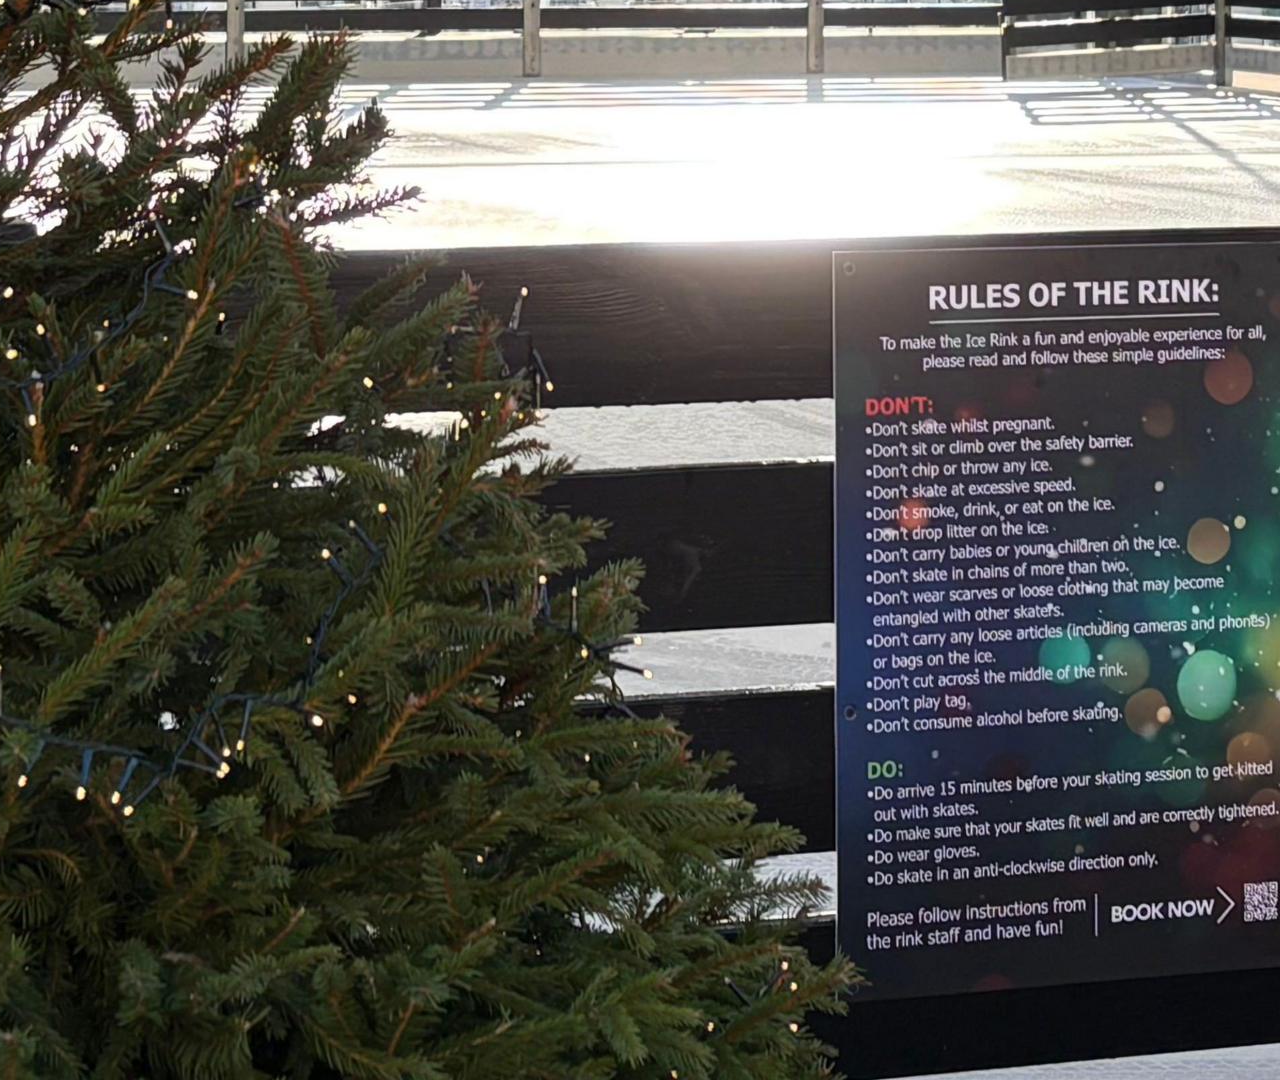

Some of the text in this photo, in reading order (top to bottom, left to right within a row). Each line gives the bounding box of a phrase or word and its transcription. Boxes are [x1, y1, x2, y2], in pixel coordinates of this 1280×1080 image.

[928, 278, 1218, 311] RULES OF THE RINK:
[879, 324, 1266, 351] To make the Ice Rink a fun and enjoyable experience for all,
[922, 345, 1225, 372] please read and follow these simple guidelines:
[865, 396, 932, 415] DON'T:
[871, 416, 1055, 436] Don't skate whilst pregnant.
[871, 433, 1134, 457] Don't sit or climb over the safety barrier.
[871, 458, 1052, 480] Don't chip or throw any ice.
[871, 477, 1076, 500] Don't skate at excessive speed.
[871, 497, 1115, 521] Don't smoke, drink, or eat on the ice.
[871, 574, 1224, 606] Don't wear scarves or loose clothing that may become
[872, 603, 1064, 629] entangled with other skaters.
[873, 662, 1127, 691] Don't cut across the middle of the rink.
[873, 692, 971, 712] Don't play tag.
[873, 704, 1123, 733] Don't consume alcohol before skating.
[867, 761, 903, 780] DO:
[872, 760, 1273, 801] Do arrive 15 minutes before your skating session to get kitted
[873, 801, 978, 822] out with skates.
[874, 801, 1279, 843] Do make sure that your skates fit well and are correctly tightened.
[872, 843, 980, 865] Do wear gloves.
[874, 851, 1158, 886] Do skate in an anti-clockwise direction only.
[867, 896, 1086, 928] Please follow instructions from
[1111, 898, 1214, 923] BOOK NOW
[866, 919, 1063, 949] the rink staff and have fun!
